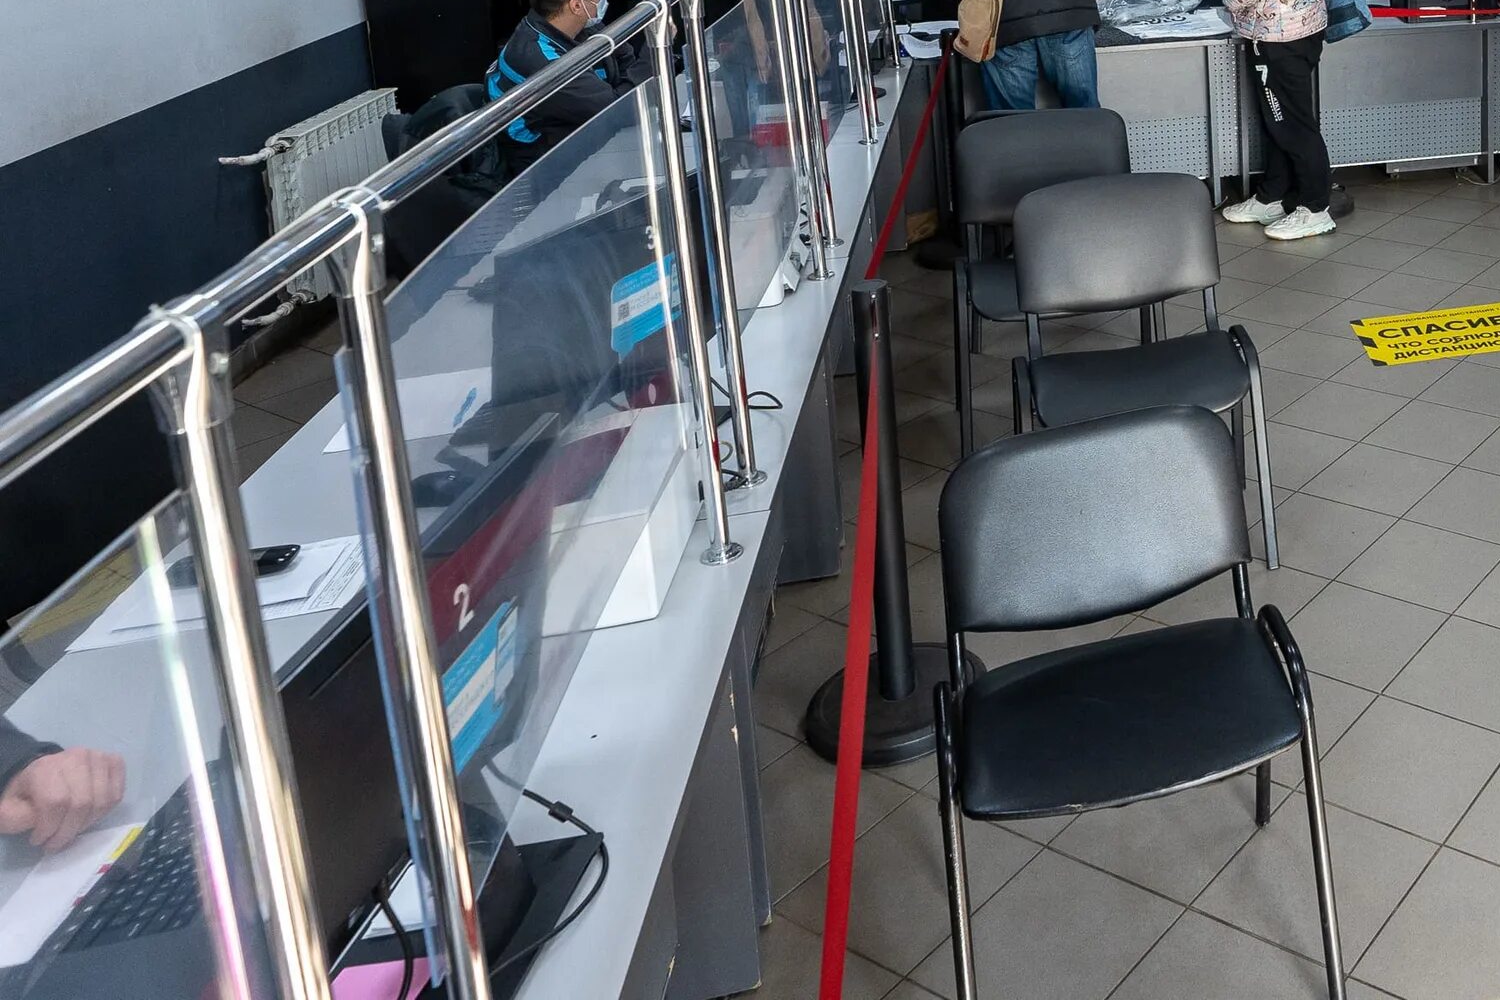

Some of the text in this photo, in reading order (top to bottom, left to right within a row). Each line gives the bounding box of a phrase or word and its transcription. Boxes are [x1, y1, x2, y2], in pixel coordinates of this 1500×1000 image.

[645, 225, 655, 250] 3
[1369, 314, 1447, 326] РЕКОМЕНДОВАННАЯ
[1449, 308, 1495, 317] ДИСТАНЦИЯ
[1387, 341, 1422, 349] ЧТО
[453, 583, 474, 633] 2
